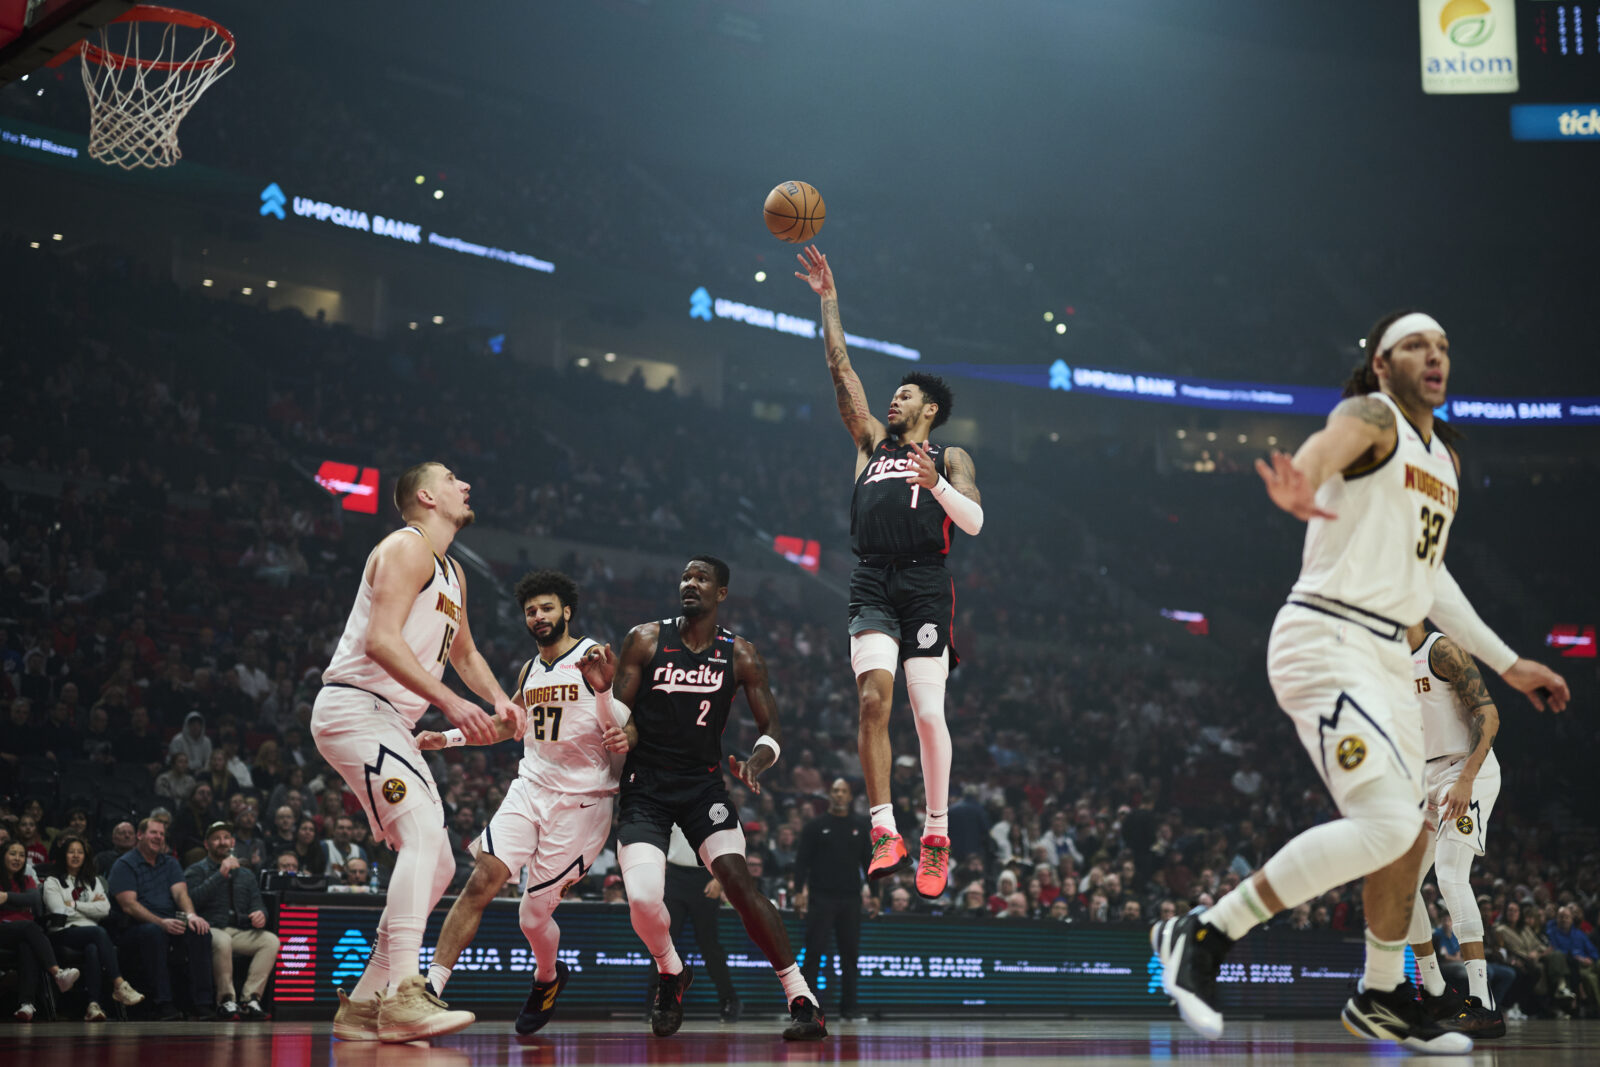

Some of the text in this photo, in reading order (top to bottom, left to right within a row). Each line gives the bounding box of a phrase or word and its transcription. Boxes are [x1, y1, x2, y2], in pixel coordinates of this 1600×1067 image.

[1427, 51, 1513, 74] axiom
[293, 196, 422, 244] UMPQUA BANK
[1452, 401, 1517, 419] UMPQUA
[1518, 402, 1563, 419] BANK
[864, 455, 921, 484] ripci
[910, 483, 920, 509] 1
[1416, 505, 1446, 567] 32
[435, 591, 462, 626] NUGGET
[652, 662, 725, 694] ripcity
[525, 684, 579, 708] NUGGETS
[532, 705, 563, 742] 27
[696, 699, 711, 727] 2
[510, 948, 583, 972] BAK
